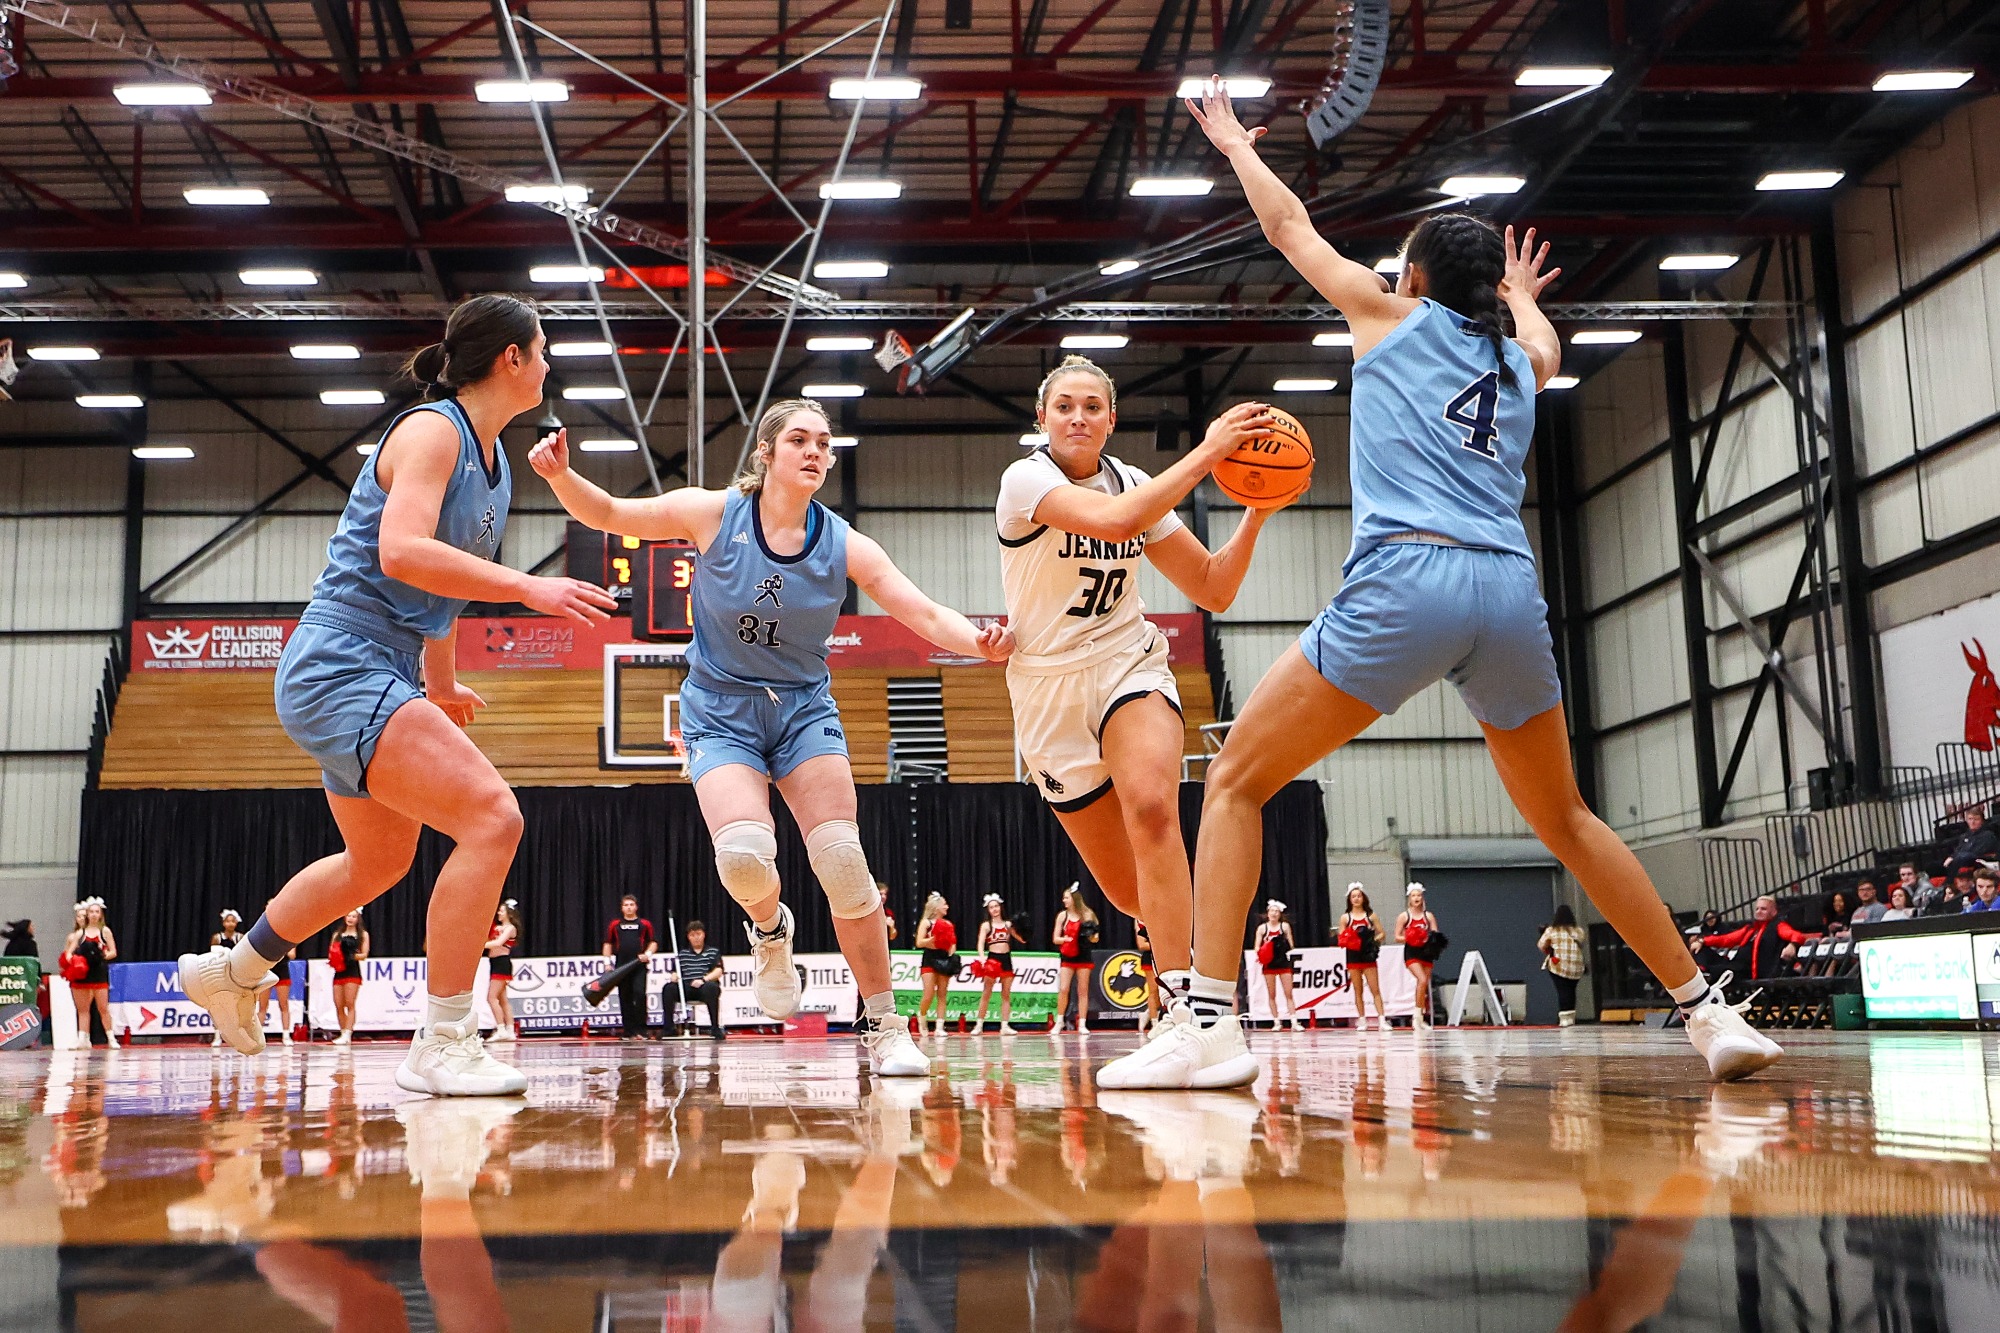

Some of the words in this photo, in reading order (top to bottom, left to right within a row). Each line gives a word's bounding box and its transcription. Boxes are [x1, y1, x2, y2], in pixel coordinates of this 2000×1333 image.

[1442, 369, 1499, 461] 4
[1058, 532, 1146, 560] JENNIES
[1065, 567, 1128, 618] 30
[211, 625, 283, 641] COLLISION
[518, 626, 574, 641] UCM
[737, 614, 780, 648] 31
[210, 641, 283, 659] LEADERS
[518, 641, 573, 653] STORE
[0, 965, 24, 976] ace
[366, 960, 393, 981] IM
[403, 960, 427, 981] HI
[546, 959, 617, 978] DIAMO
[811, 968, 850, 985] TITLE
[1010, 996, 1059, 1009] WNINGS
[162, 1007, 216, 1028] Brea
